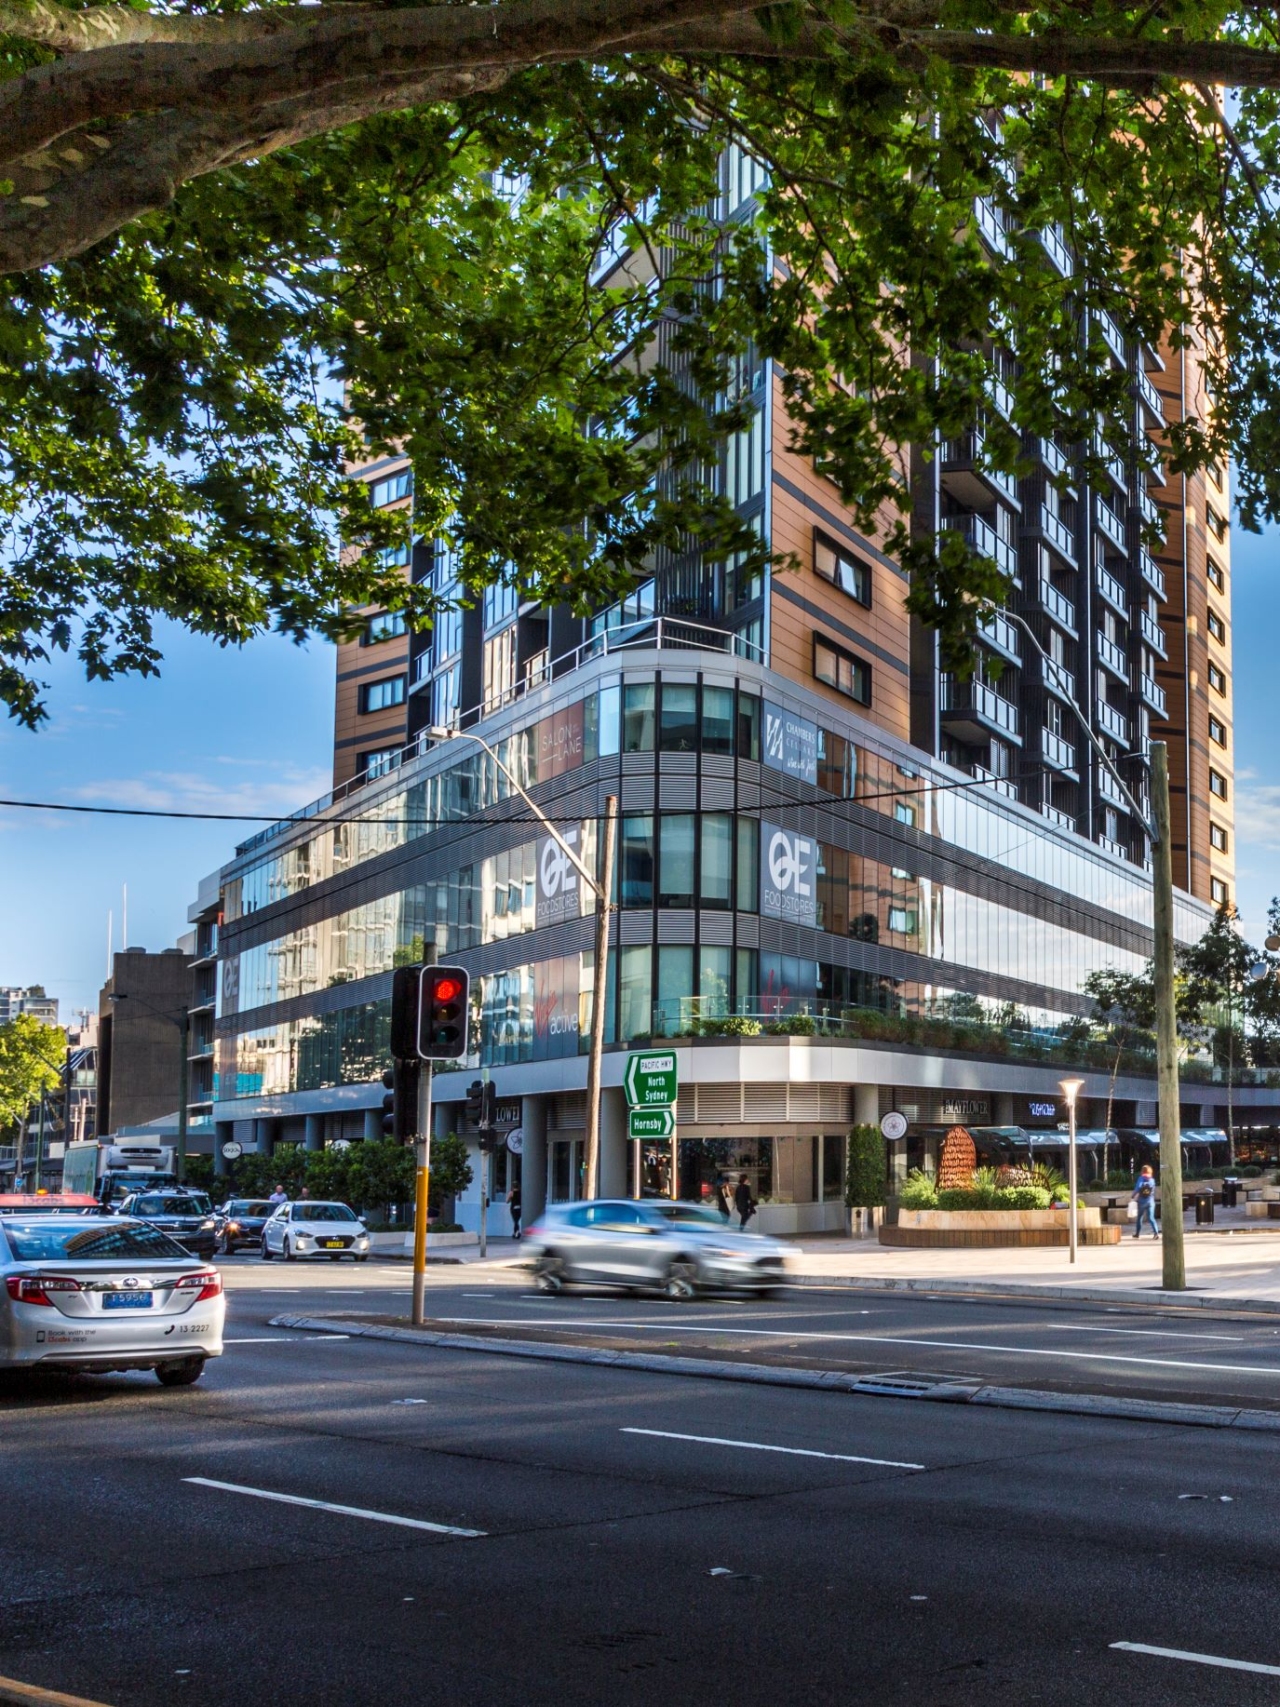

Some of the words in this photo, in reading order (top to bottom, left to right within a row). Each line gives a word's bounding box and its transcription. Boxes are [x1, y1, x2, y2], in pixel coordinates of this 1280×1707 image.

[542, 725, 572, 752] SALON
[786, 722, 816, 744] CHAMBERS
[558, 736, 582, 761] LANE
[764, 889, 815, 914] FOODSTORES
[550, 1008, 578, 1035] active
[641, 1061, 660, 1070] PACIFIC
[647, 1076, 666, 1087] North
[645, 1090, 668, 1102] Sydney
[634, 1119, 662, 1132] Hornsby
[180, 1325, 188, 1333] 13
[190, 1325, 209, 1333] 2227
